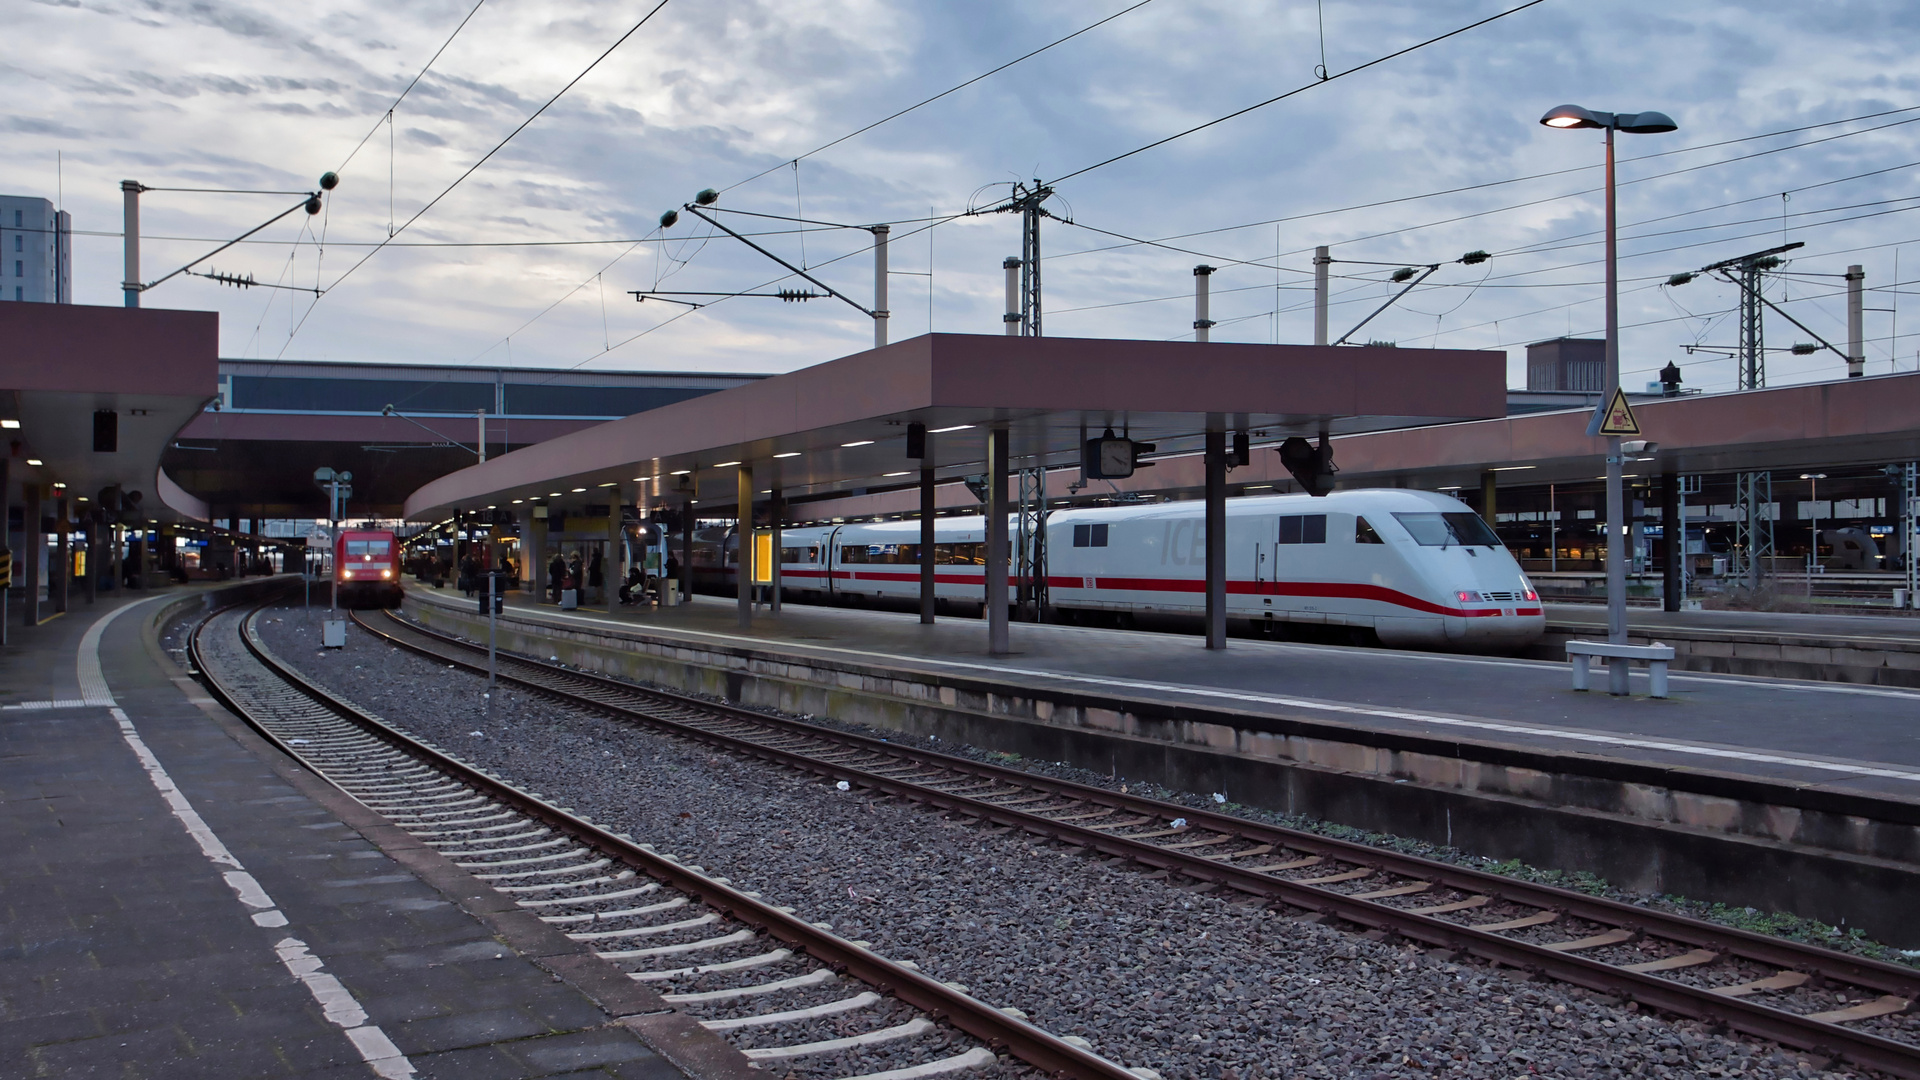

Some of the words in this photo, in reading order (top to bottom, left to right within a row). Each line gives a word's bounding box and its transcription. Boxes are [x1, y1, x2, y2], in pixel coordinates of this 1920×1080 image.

[481, 512, 494, 522] 18
[499, 511, 508, 522] A
[654, 510, 662, 521] A
[1160, 519, 1206, 566] ICE
